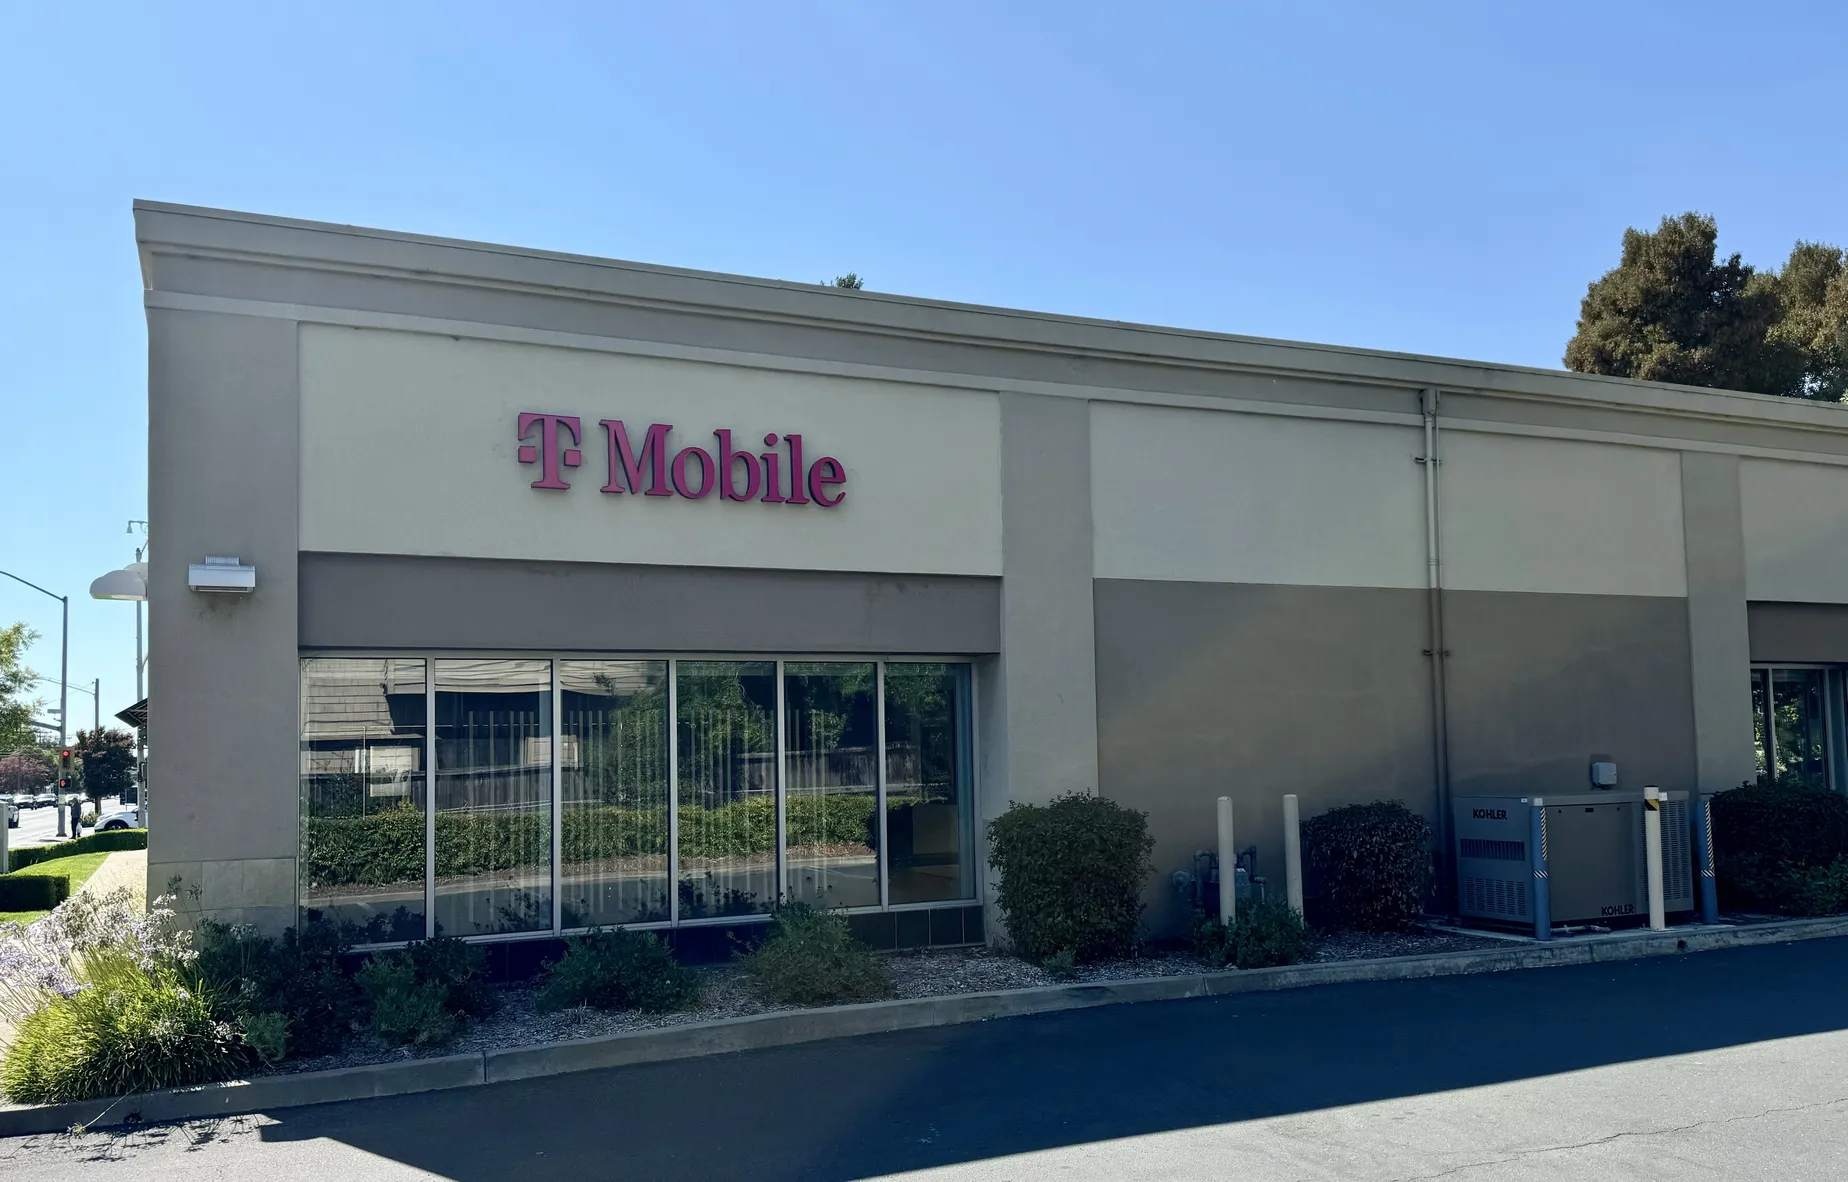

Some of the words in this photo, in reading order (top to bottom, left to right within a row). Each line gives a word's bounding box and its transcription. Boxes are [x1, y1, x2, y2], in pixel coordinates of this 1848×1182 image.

[599, 418, 846, 507] Mobile
[1472, 808, 1508, 820] KOHLER
[1601, 904, 1634, 916] KOHLER
